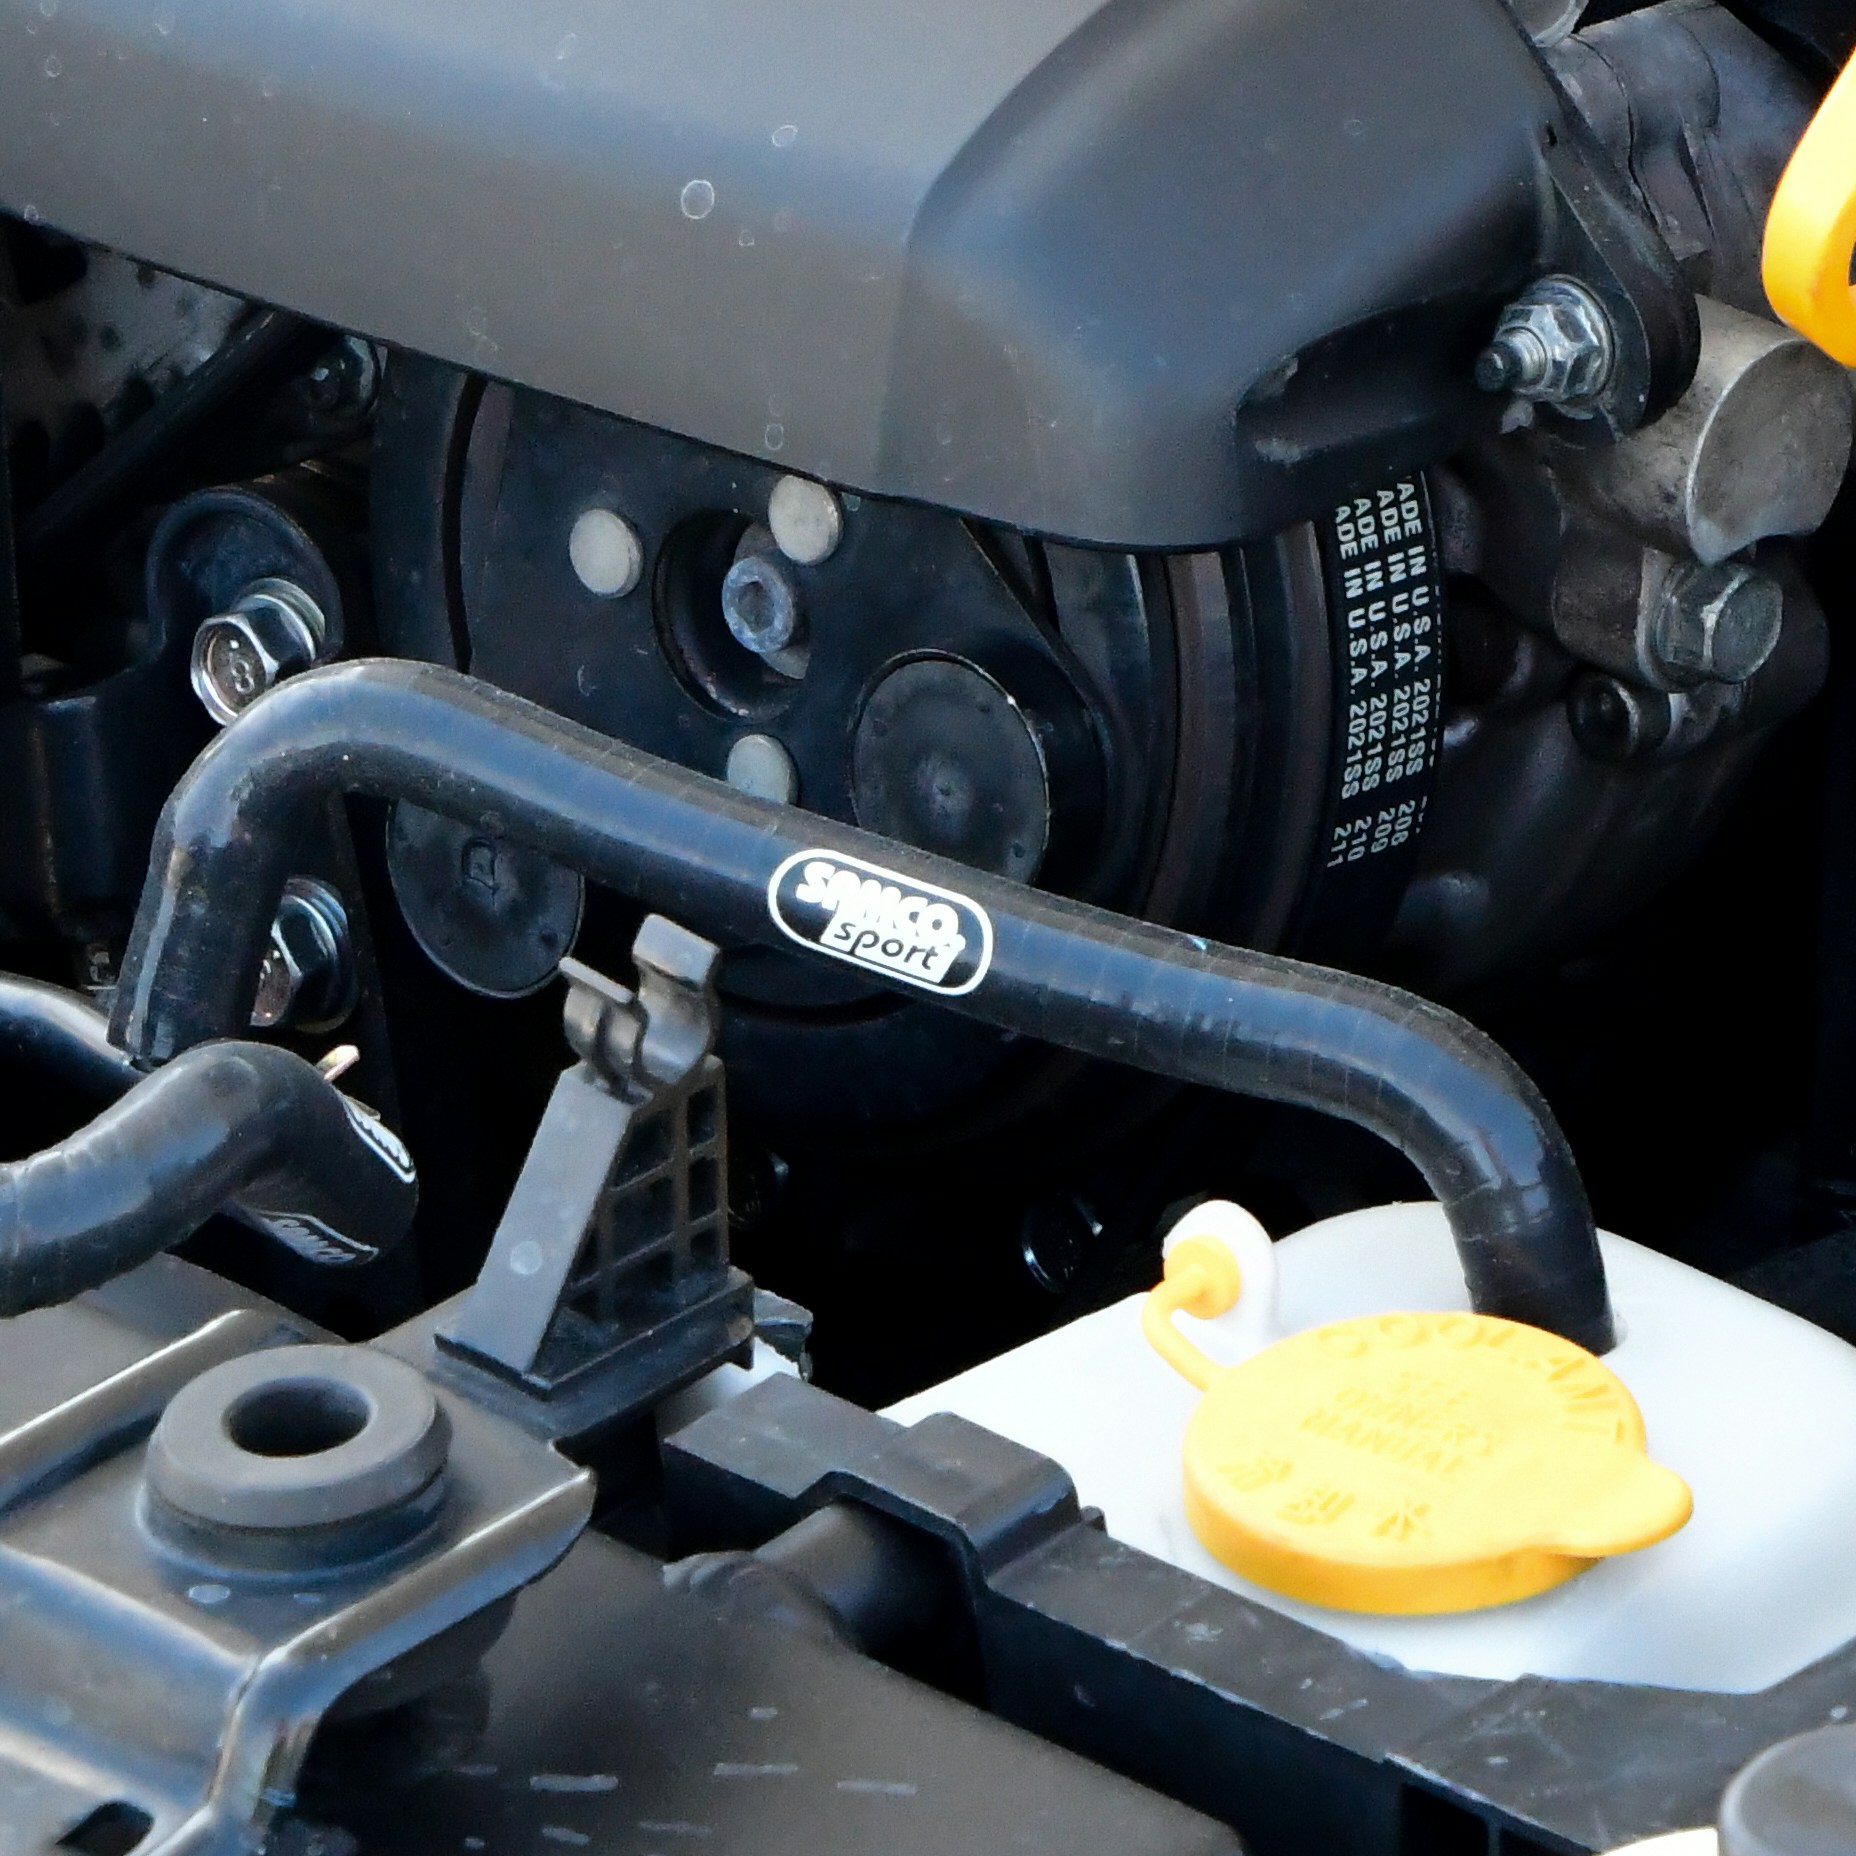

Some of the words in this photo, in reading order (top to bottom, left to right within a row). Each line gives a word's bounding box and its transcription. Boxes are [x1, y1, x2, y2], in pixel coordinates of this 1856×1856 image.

[1343, 568, 1363, 599] IN
[1363, 560, 1384, 592] IN
[1387, 551, 1408, 584] IN
[1407, 545, 1428, 576] IN
[1347, 607, 1368, 694] U.S.A.
[1368, 599, 1389, 687] U.S.A.
[1391, 591, 1412, 679] U.S.A.
[1411, 585, 1432, 673] U.S.A.
[1341, 701, 1368, 801] 2021SS
[1362, 693, 1388, 792] 2021SS
[1385, 685, 1411, 784] 2021SS
[1405, 678, 1432, 776] 2021SS
[1326, 823, 1352, 868] 211
[1347, 816, 1372, 862] 210
[1370, 807, 1397, 855] 209
[1390, 799, 1416, 847] 208
[833, 921, 939, 971] sport
[1317, 1313, 1628, 1445] COOLANT
